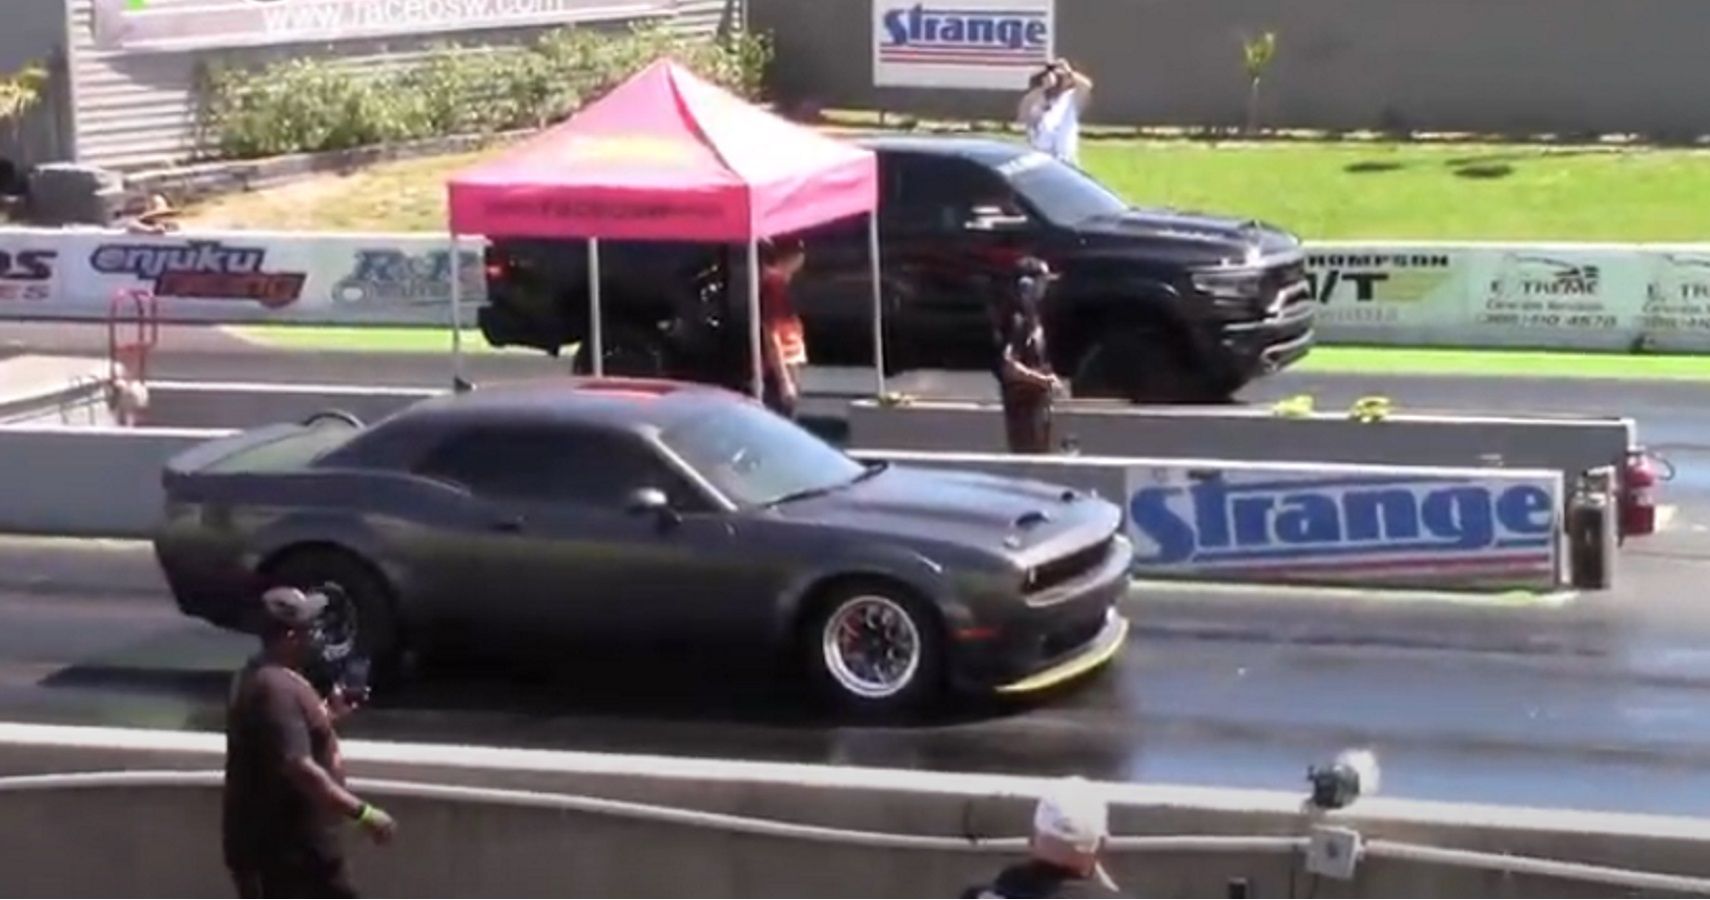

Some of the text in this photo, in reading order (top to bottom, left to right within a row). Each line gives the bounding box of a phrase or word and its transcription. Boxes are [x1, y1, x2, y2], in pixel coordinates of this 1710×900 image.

[884, 4, 1048, 50] Strange
[1304, 254, 1449, 267] HOMPSON
[1131, 470, 1551, 565] Strange
